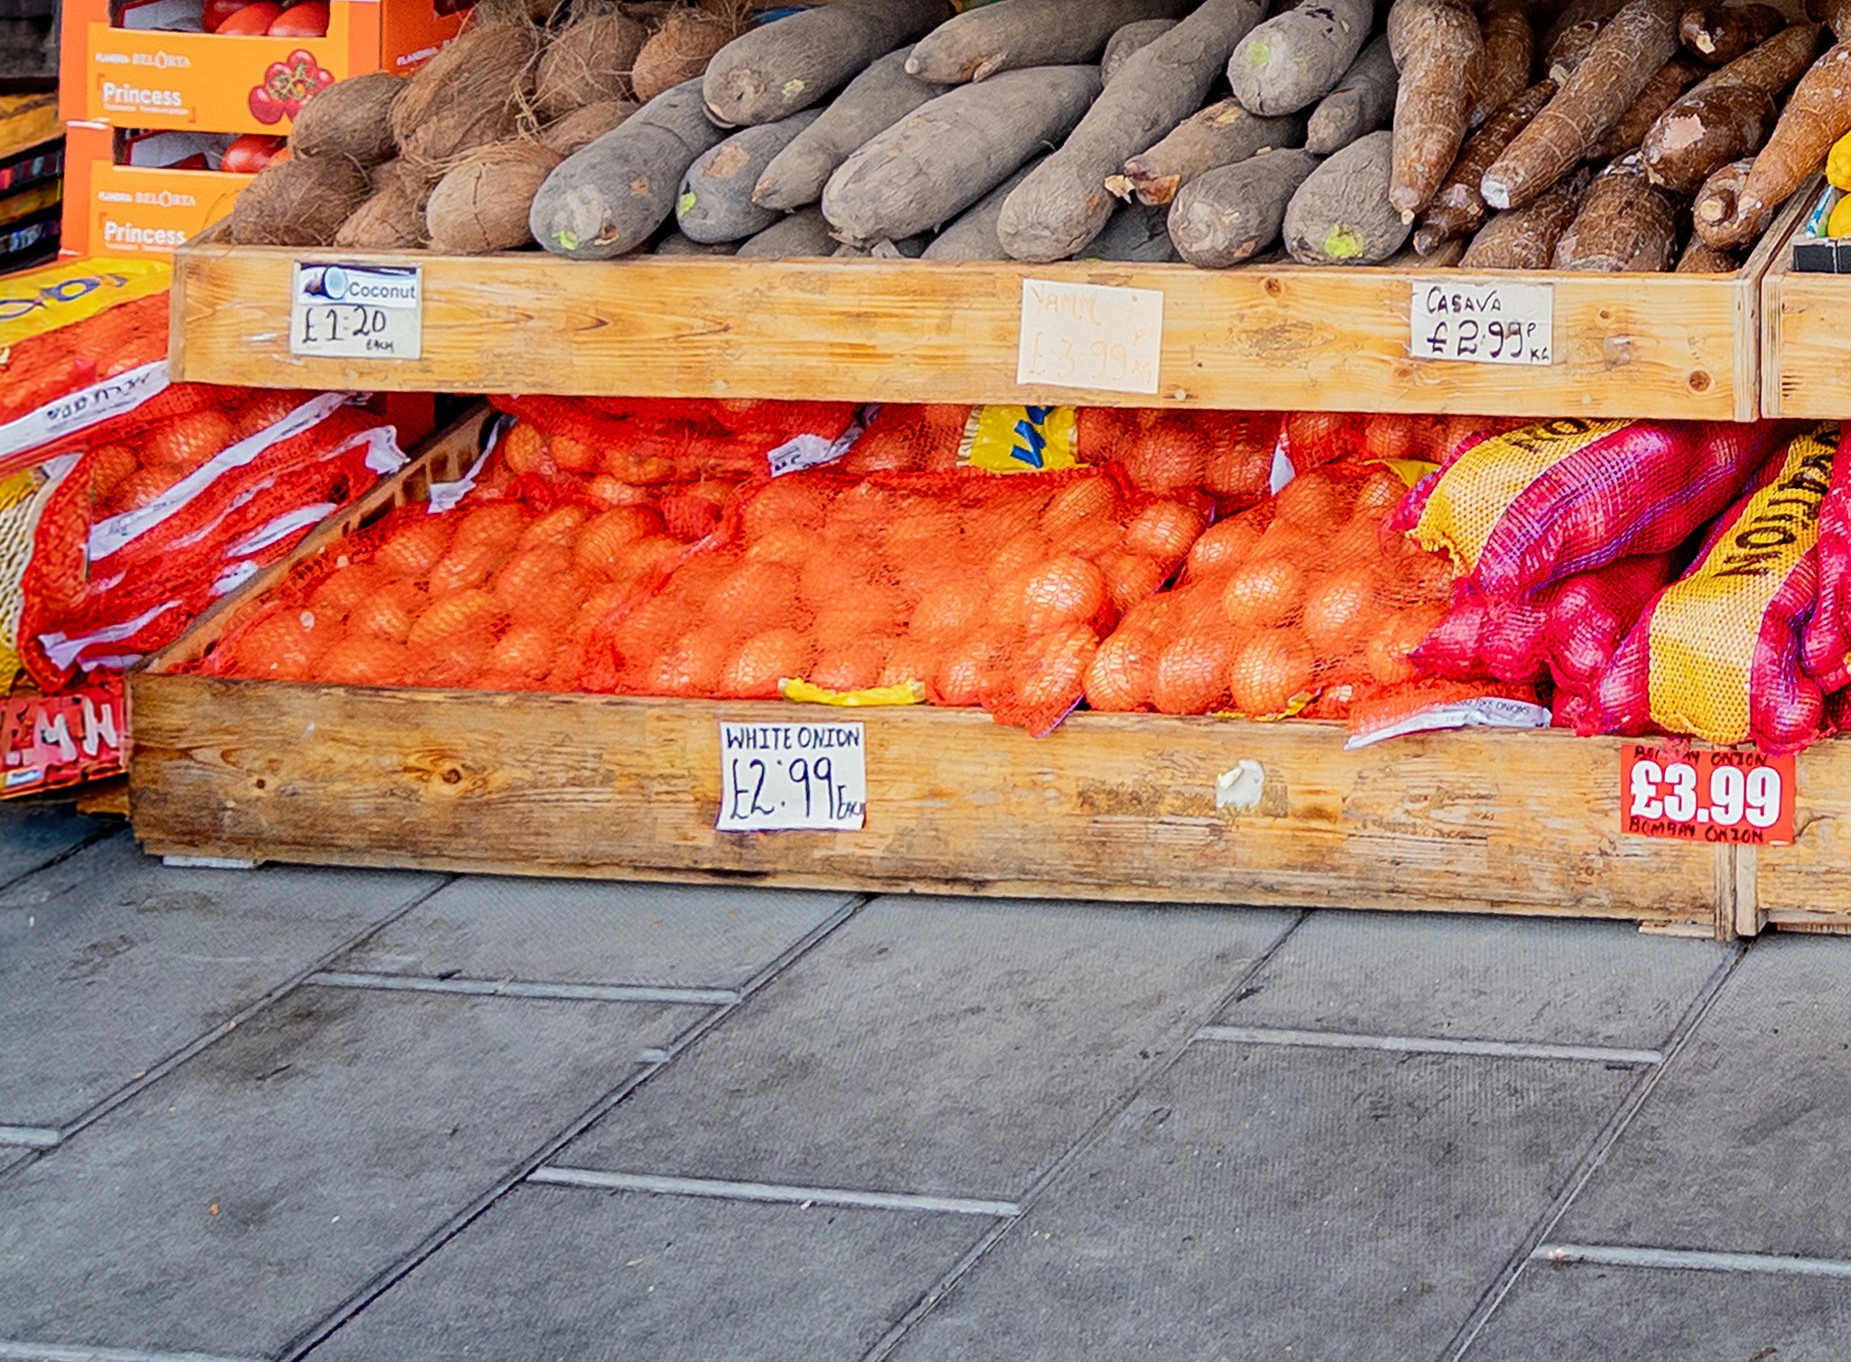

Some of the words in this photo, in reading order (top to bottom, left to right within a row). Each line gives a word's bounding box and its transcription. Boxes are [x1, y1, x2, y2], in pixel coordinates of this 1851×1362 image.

[102, 83, 183, 107] Princess
[104, 221, 187, 245] Princess
[349, 281, 416, 299] Coconut
[1426, 286, 1502, 314] CASAVA
[725, 727, 793, 750] WHITE
[797, 726, 861, 749] ONION
[1710, 750, 1768, 768] ONION
[1630, 759, 1783, 829] £3.99
[1704, 825, 1765, 844] ONION
